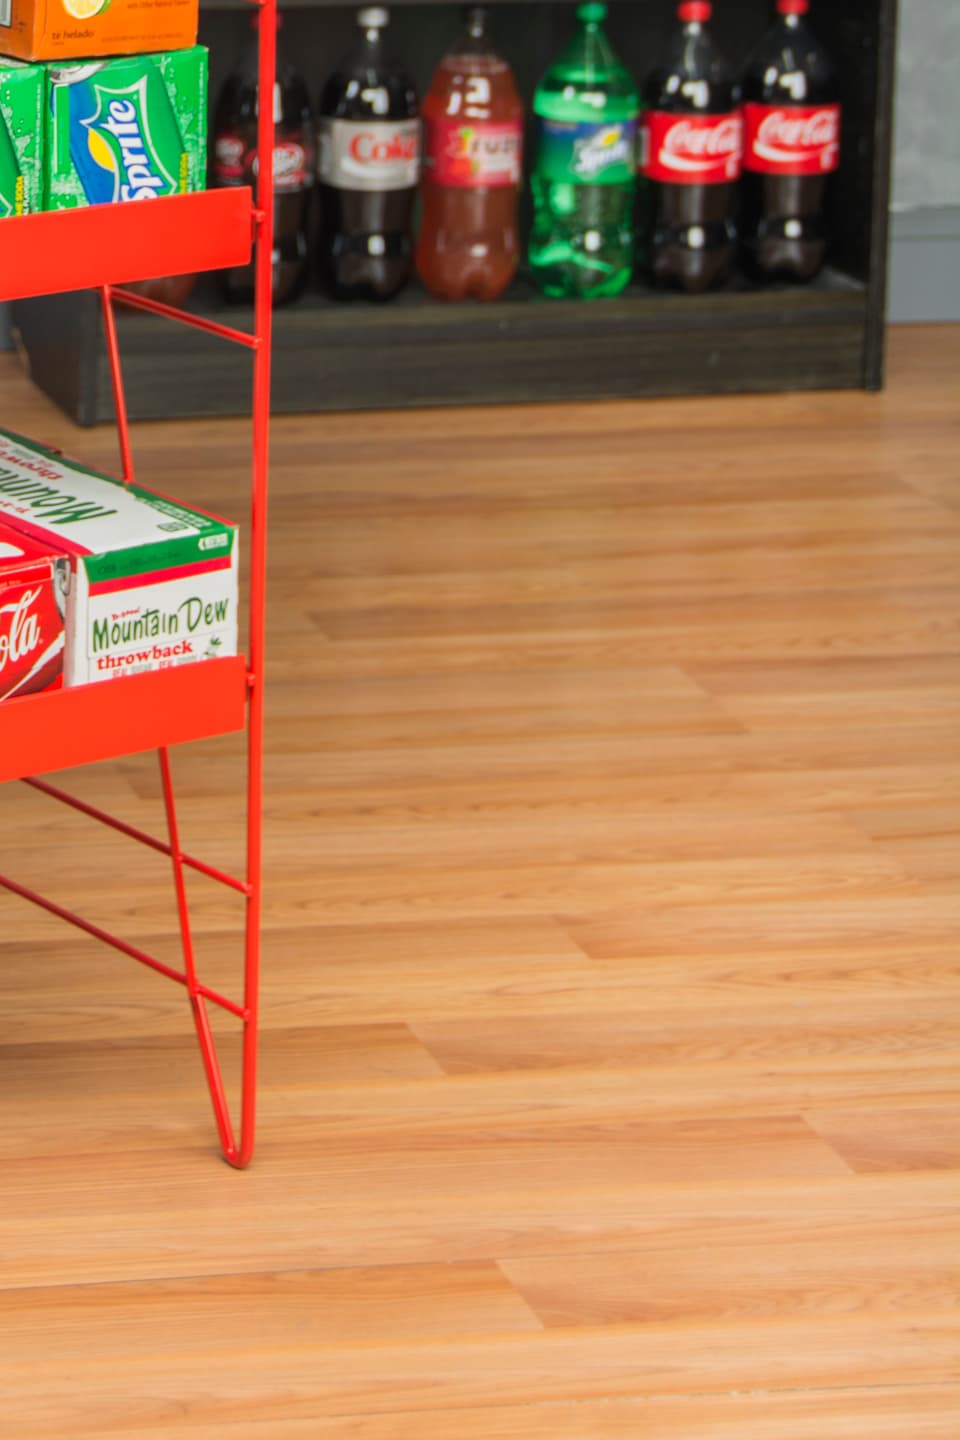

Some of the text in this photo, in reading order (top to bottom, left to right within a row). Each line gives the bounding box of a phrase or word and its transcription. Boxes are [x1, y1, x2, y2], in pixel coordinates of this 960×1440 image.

[100, 98, 165, 203] Sprite
[92, 596, 230, 653] Mountain Dew
[96, 639, 194, 670] throwback
